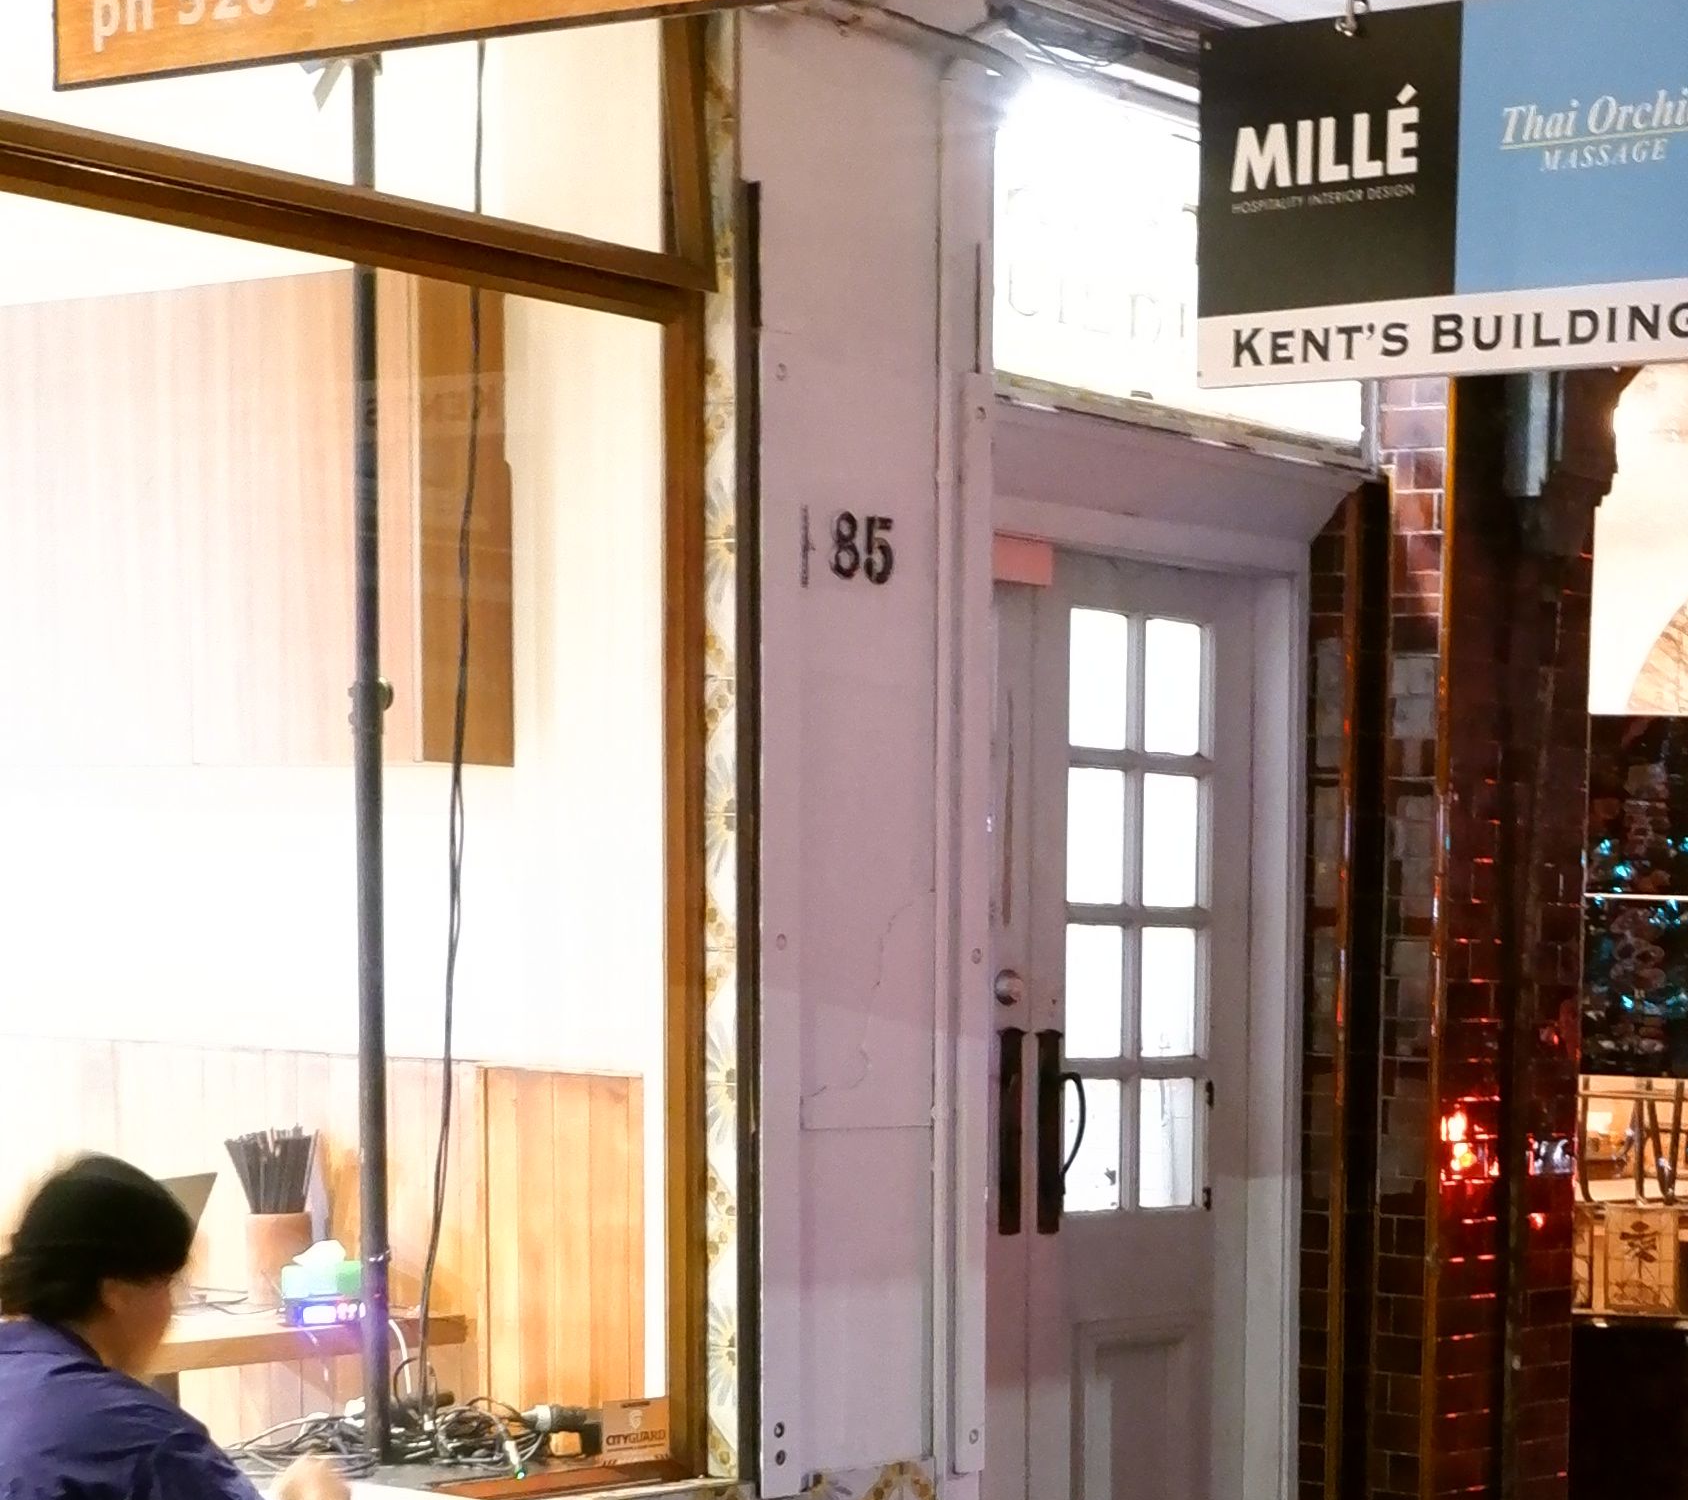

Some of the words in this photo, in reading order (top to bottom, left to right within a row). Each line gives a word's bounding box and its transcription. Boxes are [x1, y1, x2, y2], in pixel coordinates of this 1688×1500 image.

[1230, 82, 1420, 193] MILLÉ
[1502, 98, 1579, 144] Thai
[1540, 138, 1669, 172] MASSAGE
[1232, 323, 1410, 368] KENT'S
[605, 1428, 667, 1447] CITYGUARD
